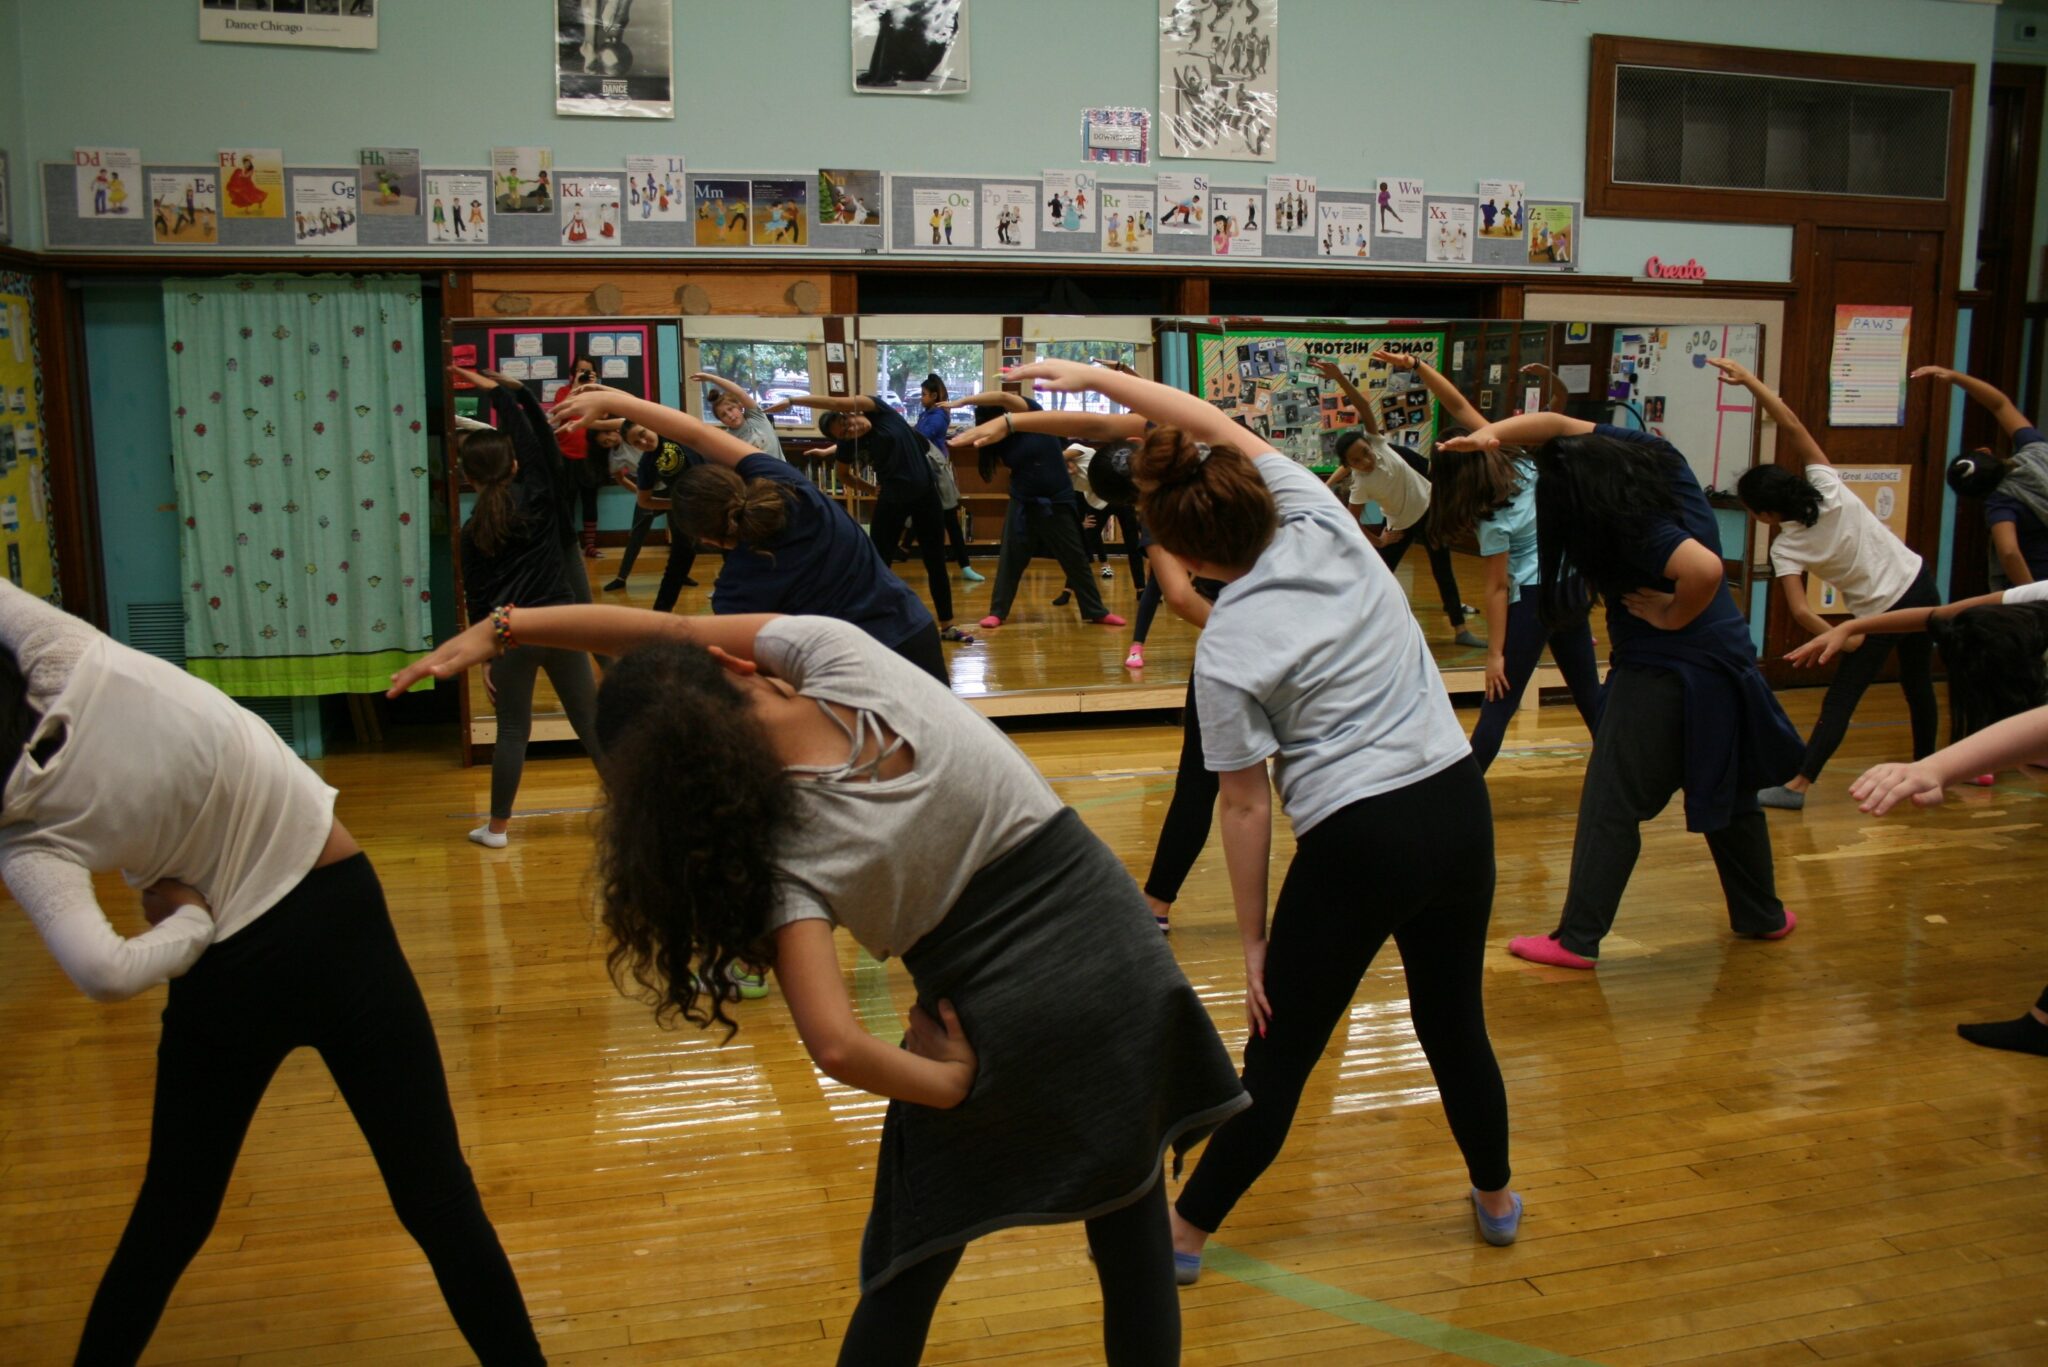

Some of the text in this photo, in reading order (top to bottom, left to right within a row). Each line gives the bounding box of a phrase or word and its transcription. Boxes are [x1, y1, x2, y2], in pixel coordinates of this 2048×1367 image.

[225, 18, 259, 31] Dance
[260, 20, 303, 35] Chicago
[602, 84, 628, 94] DANCE
[75, 151, 100, 167] Dd
[219, 152, 237, 168] Ff
[360, 150, 385, 166] Hh
[194, 178, 216, 194] Ee
[822, 171, 846, 187] Nn
[1074, 173, 1095, 190] Qq
[1193, 177, 1208, 191] Ss
[1296, 179, 1315, 193] Uu
[331, 181, 355, 198] Gg
[562, 183, 584, 198] Kk
[695, 184, 724, 199] Mm
[1398, 181, 1423, 195] Ww
[1508, 184, 1523, 199] Yy
[948, 193, 969, 208] Oo
[983, 189, 1001, 207] Pp
[1103, 194, 1121, 208] Rr
[1212, 197, 1227, 211] Tt
[1321, 206, 1340, 220] Vv
[1429, 206, 1447, 220] Xx
[1528, 208, 1542, 221] Zz
[1645, 256, 1706, 280] Create
[1854, 318, 1893, 330] PAWS
[1842, 471, 1862, 481] Great
[1864, 472, 1899, 480] AUDIENCE
